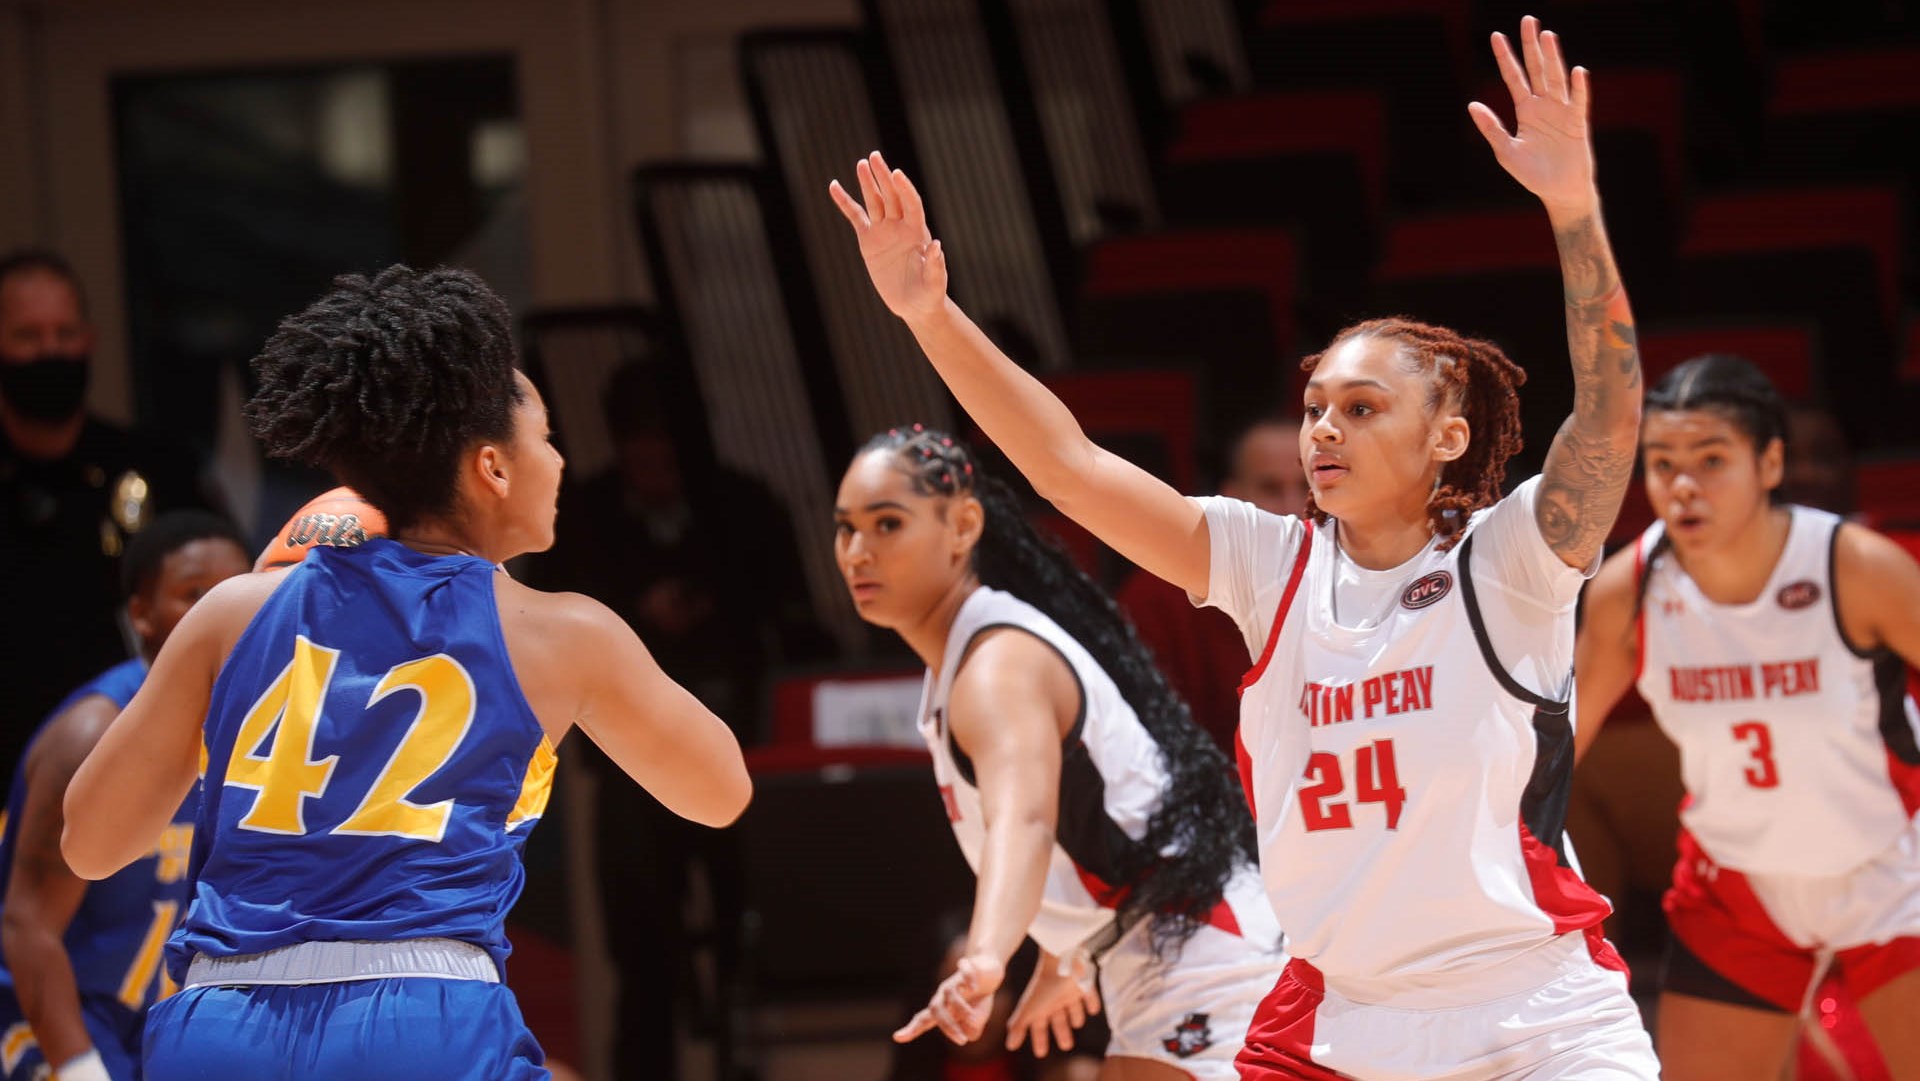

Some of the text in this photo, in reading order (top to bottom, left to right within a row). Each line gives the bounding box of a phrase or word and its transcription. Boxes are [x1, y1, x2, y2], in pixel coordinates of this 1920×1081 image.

[1410, 579, 1441, 601] OVC
[1361, 664, 1435, 720] PEAY
[1669, 656, 1820, 703] AUSTIN PEAY
[223, 634, 477, 843] 42
[1731, 720, 1780, 790] 3
[1297, 737, 1407, 834] 24
